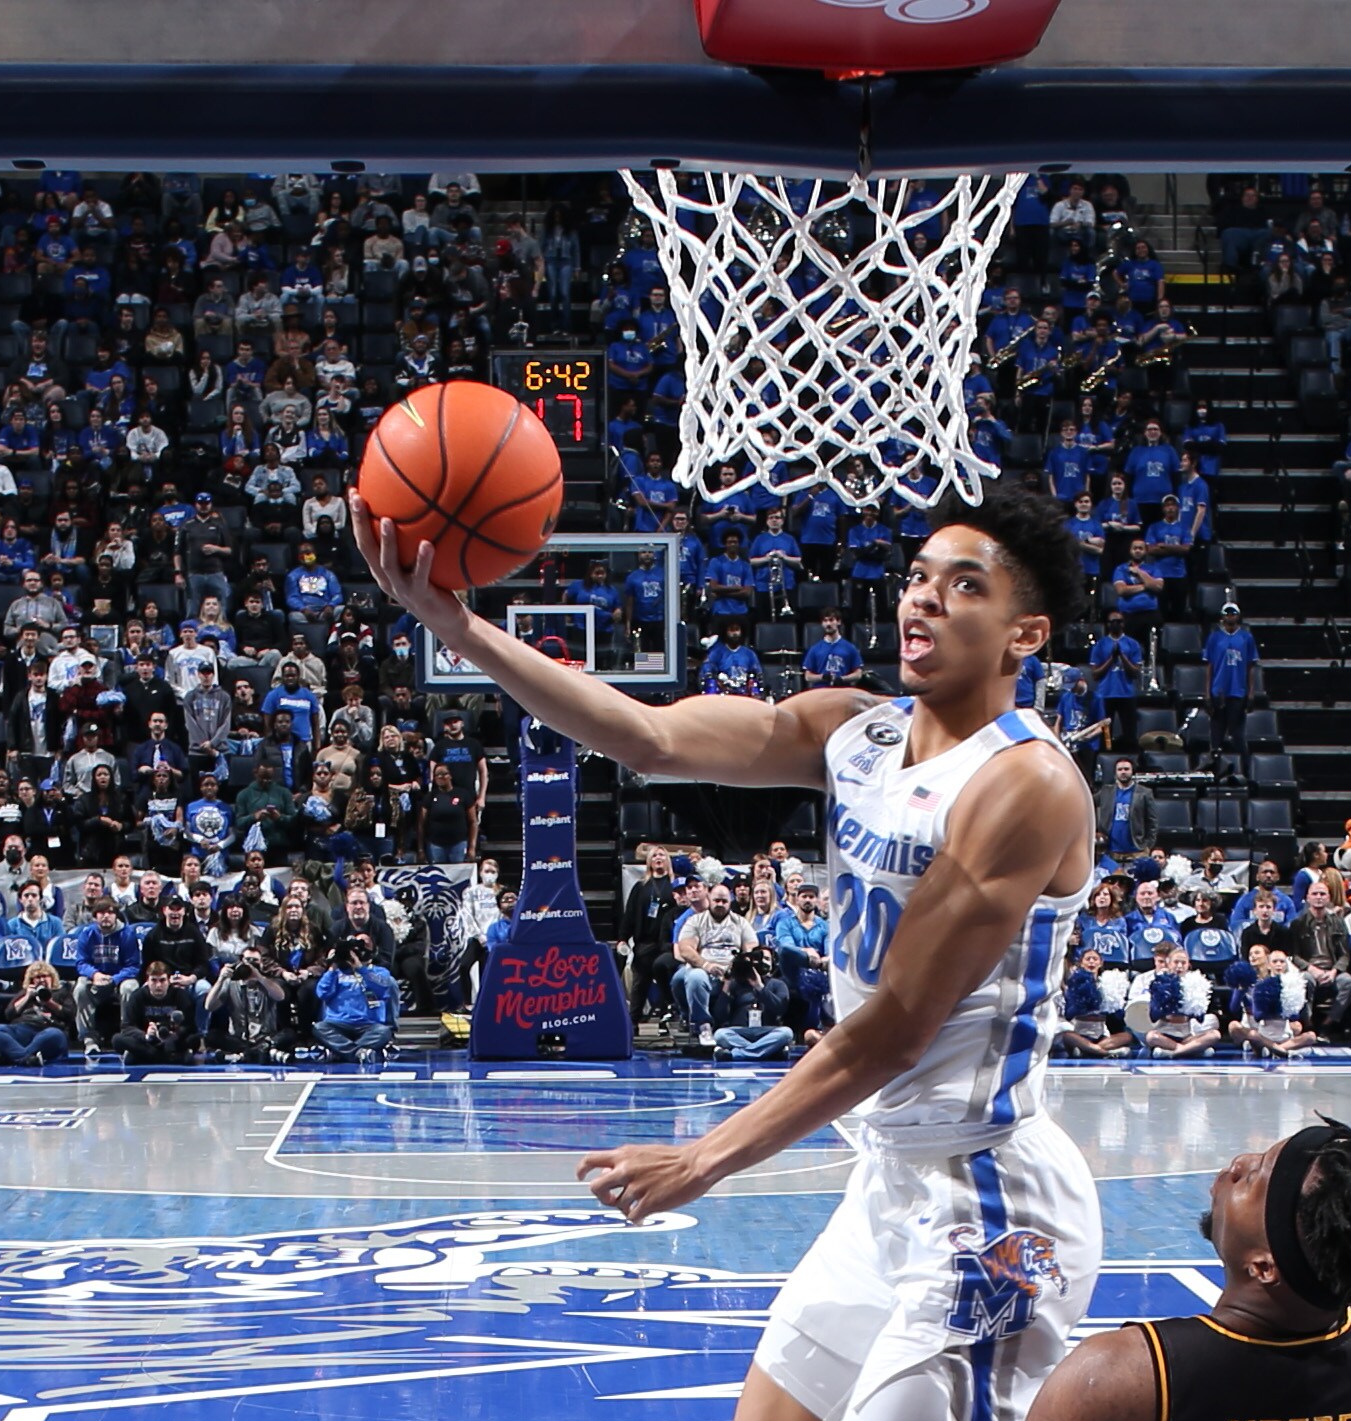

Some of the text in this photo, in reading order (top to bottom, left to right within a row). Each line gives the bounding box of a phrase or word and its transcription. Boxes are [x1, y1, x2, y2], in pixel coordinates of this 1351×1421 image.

[525, 361, 590, 391] 6:42
[526, 771, 569, 783] allegiant
[529, 815, 571, 828] allegiant
[829, 797, 936, 878] Memhis
[530, 859, 572, 872] allegiant
[520, 908, 583, 922] allegiant.com
[833, 872, 905, 985] 20
[501, 957, 527, 985] I
[495, 979, 608, 1030] Memphis
[541, 1013, 597, 1030] BLOG.COM
